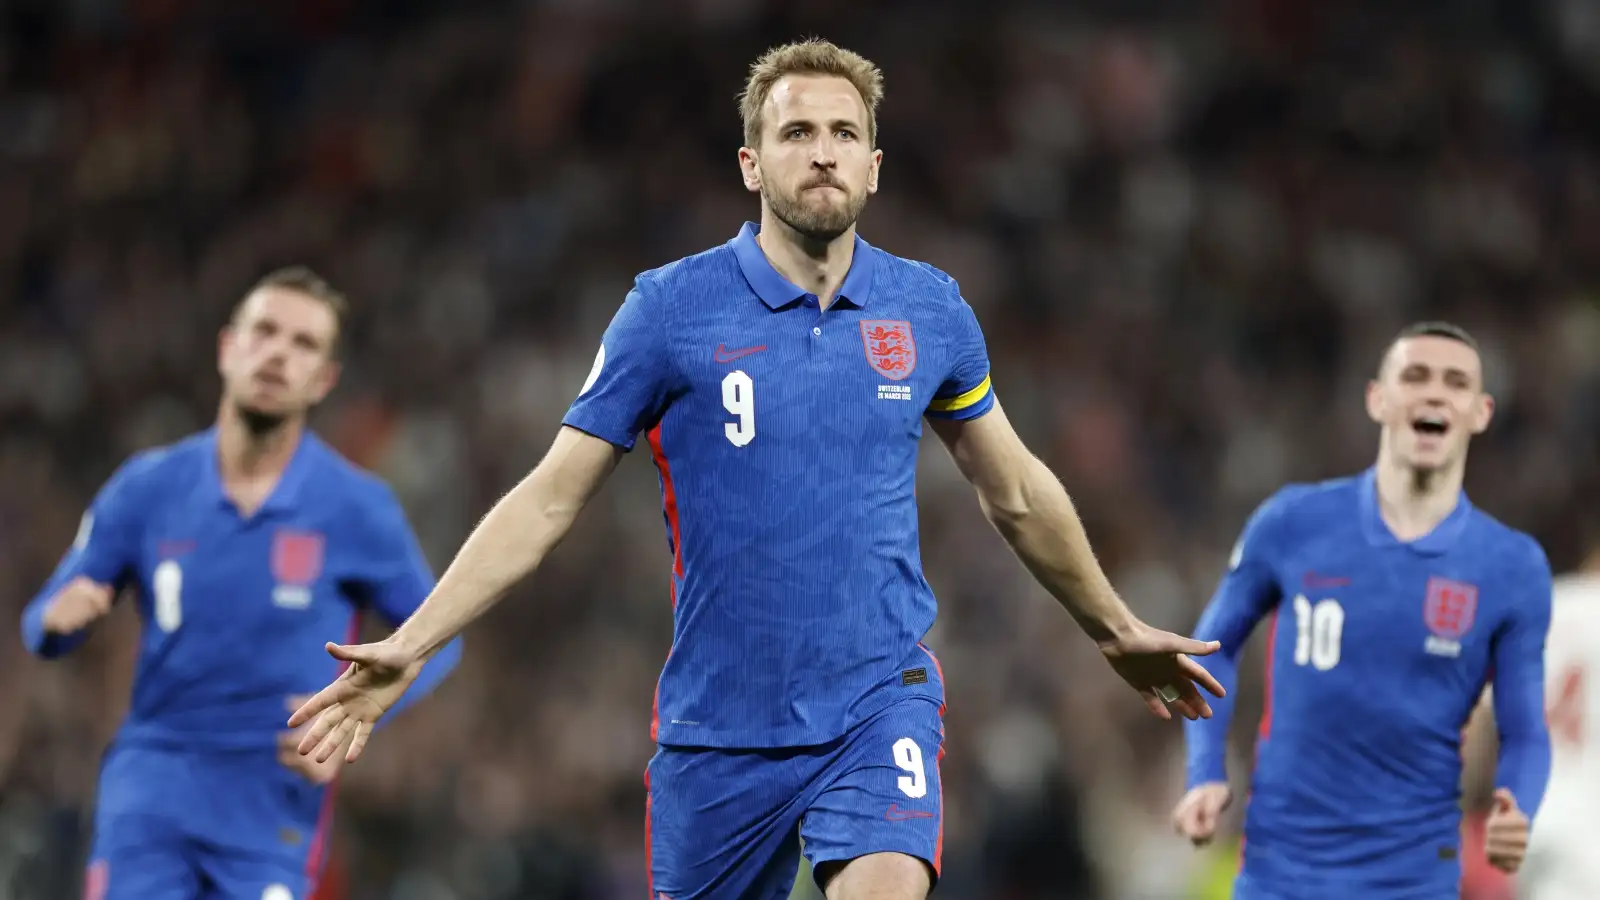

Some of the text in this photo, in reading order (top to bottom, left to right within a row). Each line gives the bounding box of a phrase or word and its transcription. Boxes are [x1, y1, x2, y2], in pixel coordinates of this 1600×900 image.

[721, 369, 756, 448] 9
[1293, 592, 1345, 671] 10
[892, 737, 927, 799] 9
